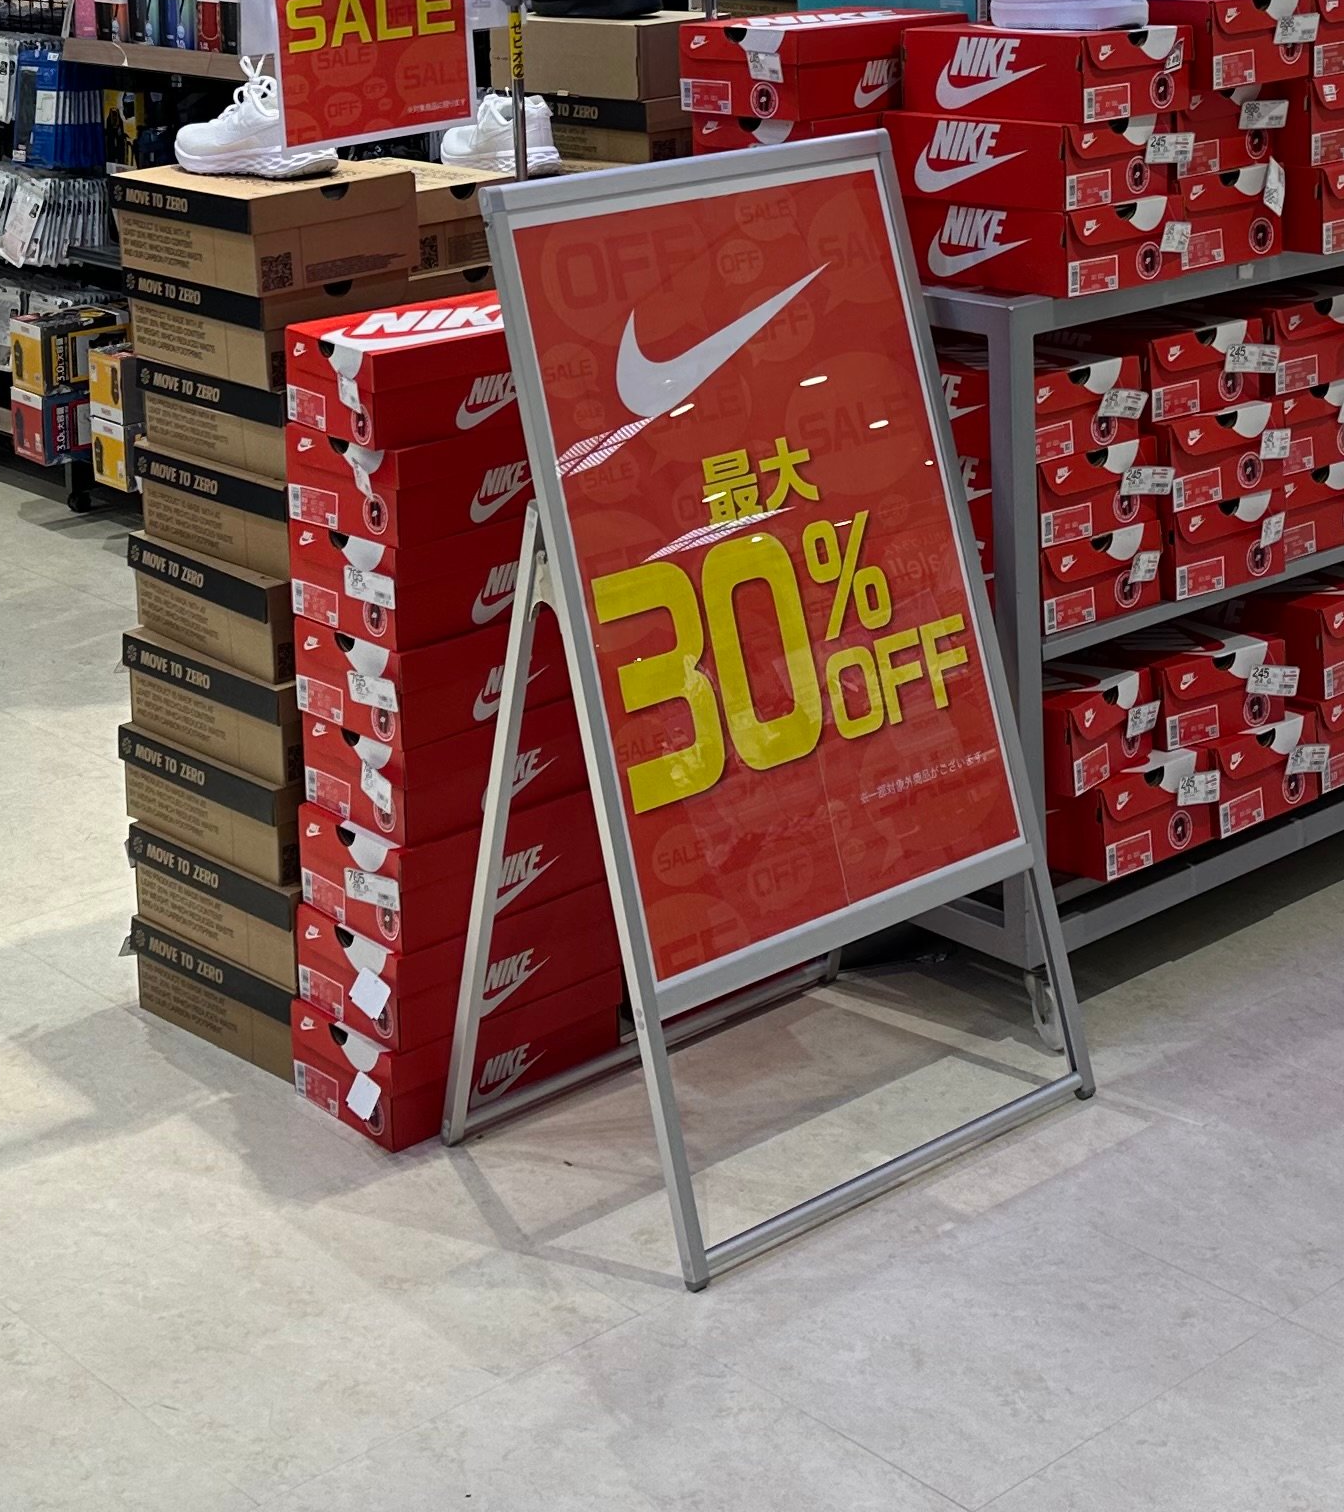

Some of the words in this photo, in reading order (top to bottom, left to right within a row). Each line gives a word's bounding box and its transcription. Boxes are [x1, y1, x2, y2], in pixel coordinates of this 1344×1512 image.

[861, 58, 900, 86] NIKE
[949, 36, 1021, 78] NIKE
[557, 104, 569, 116] TO
[573, 105, 598, 120] ZERO
[928, 120, 1001, 162] NIKE
[126, 188, 151, 205] MOVE
[152, 192, 164, 208] TO
[165, 194, 189, 213] ZERO
[939, 205, 1008, 249] NIKE
[137, 277, 163, 295] MOVE
[164, 282, 177, 300] TO
[178, 285, 202, 305] ZERO
[152, 371, 179, 391] MOVE
[181, 379, 195, 395] TO
[196, 382, 220, 403] ZERO
[150, 461, 177, 481] MOVE
[179, 470, 192, 487] TO
[193, 476, 218, 496] ZERO
[479, 459, 528, 499] NIKE
[702, 436, 820, 525] 最大
[142, 549, 168, 571] MOVE
[167, 561, 179, 577] TO
[181, 565, 204, 589] ZERO
[140, 649, 169, 673] MOVE
[170, 661, 183, 679] TO
[185, 665, 210, 690] ZERO
[135, 742, 162, 767] MOVE
[164, 756, 178, 775] TO
[180, 762, 205, 786] ZERO
[146, 842, 175, 867] MOVE
[177, 856, 190, 875] TO
[192, 861, 219, 888] ZERO
[148, 935, 177, 962] MOVE
[180, 950, 194, 970] TO
[196, 956, 223, 984] ZERO
[485, 947, 535, 990] NIKE
[483, 1042, 531, 1084] NIKE
